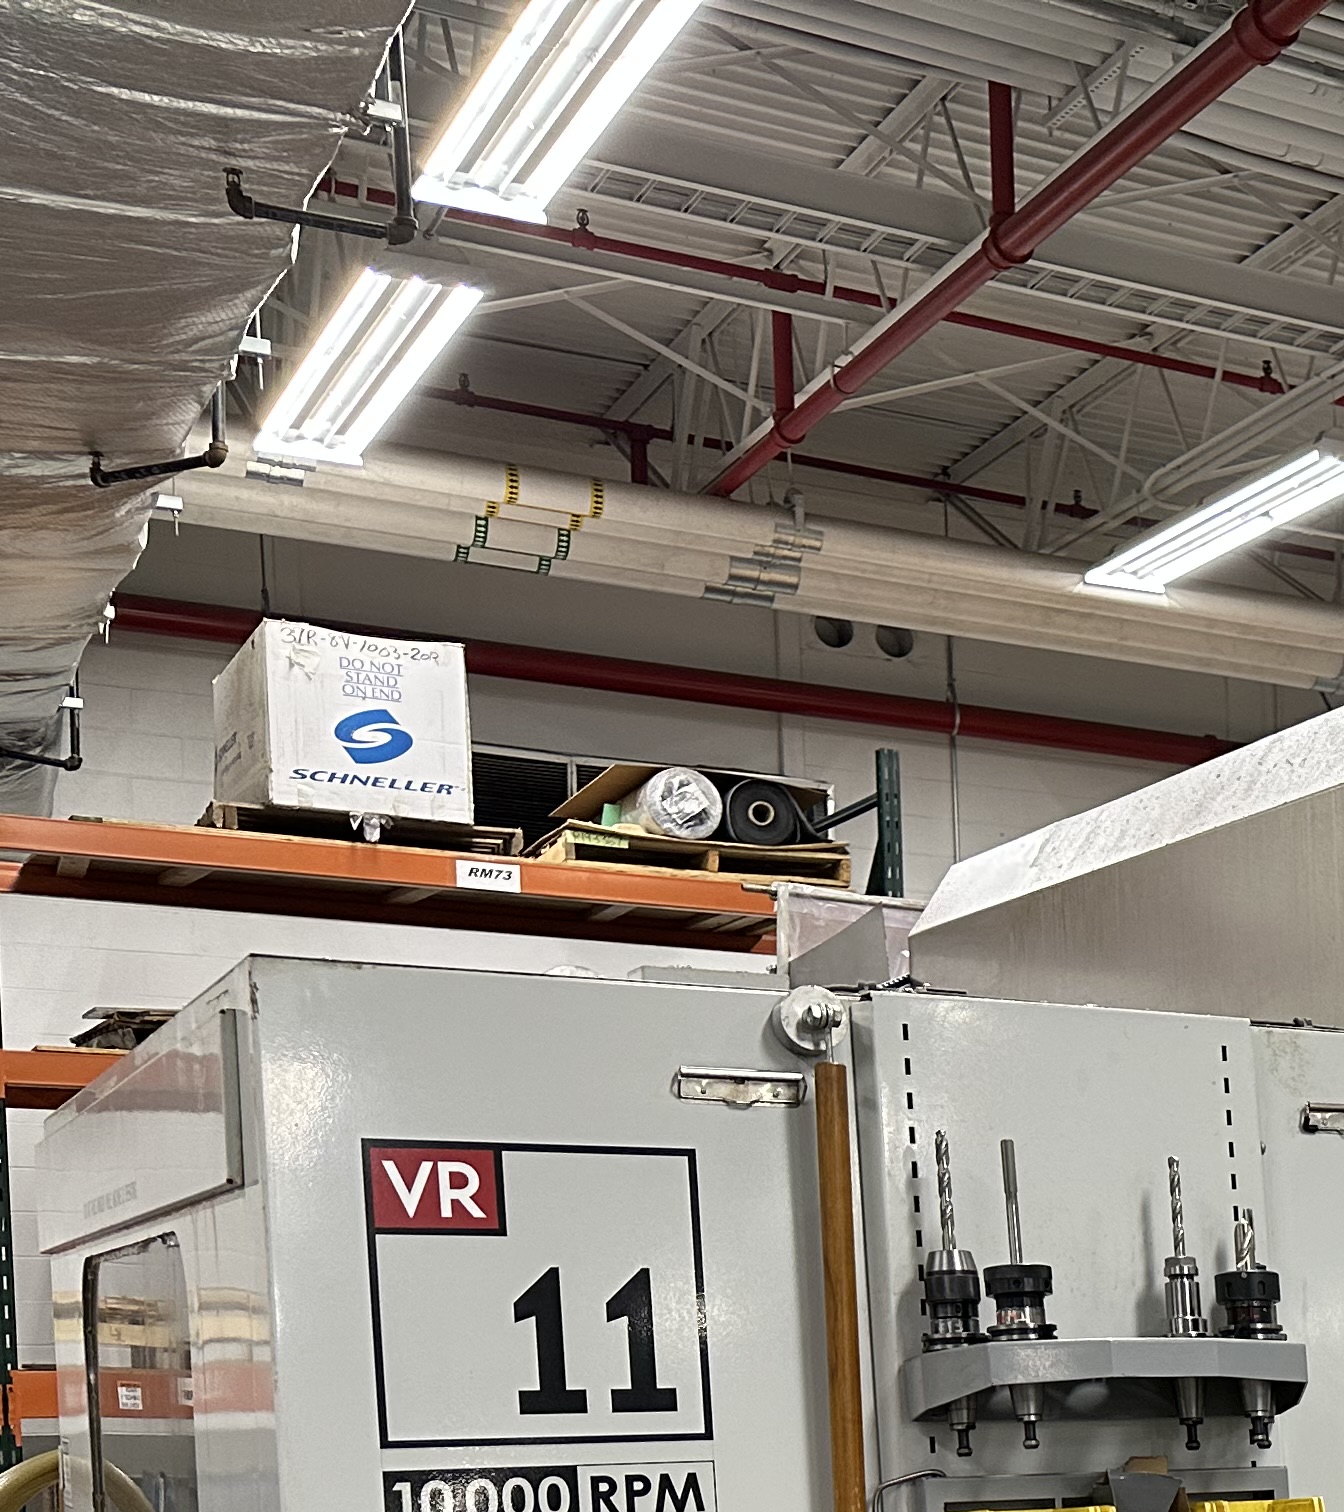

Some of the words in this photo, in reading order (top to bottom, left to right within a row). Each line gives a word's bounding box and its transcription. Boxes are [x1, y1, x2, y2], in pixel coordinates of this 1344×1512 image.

[339, 656, 365, 670] DO
[369, 661, 403, 676] NOT
[345, 671, 398, 687] STAND
[342, 684, 368, 696] ON
[372, 688, 402, 701] END
[289, 768, 454, 796] SCHNELLER
[468, 867, 513, 882] RM73
[381, 1160, 487, 1218] VR
[513, 1266, 678, 1415] 11
